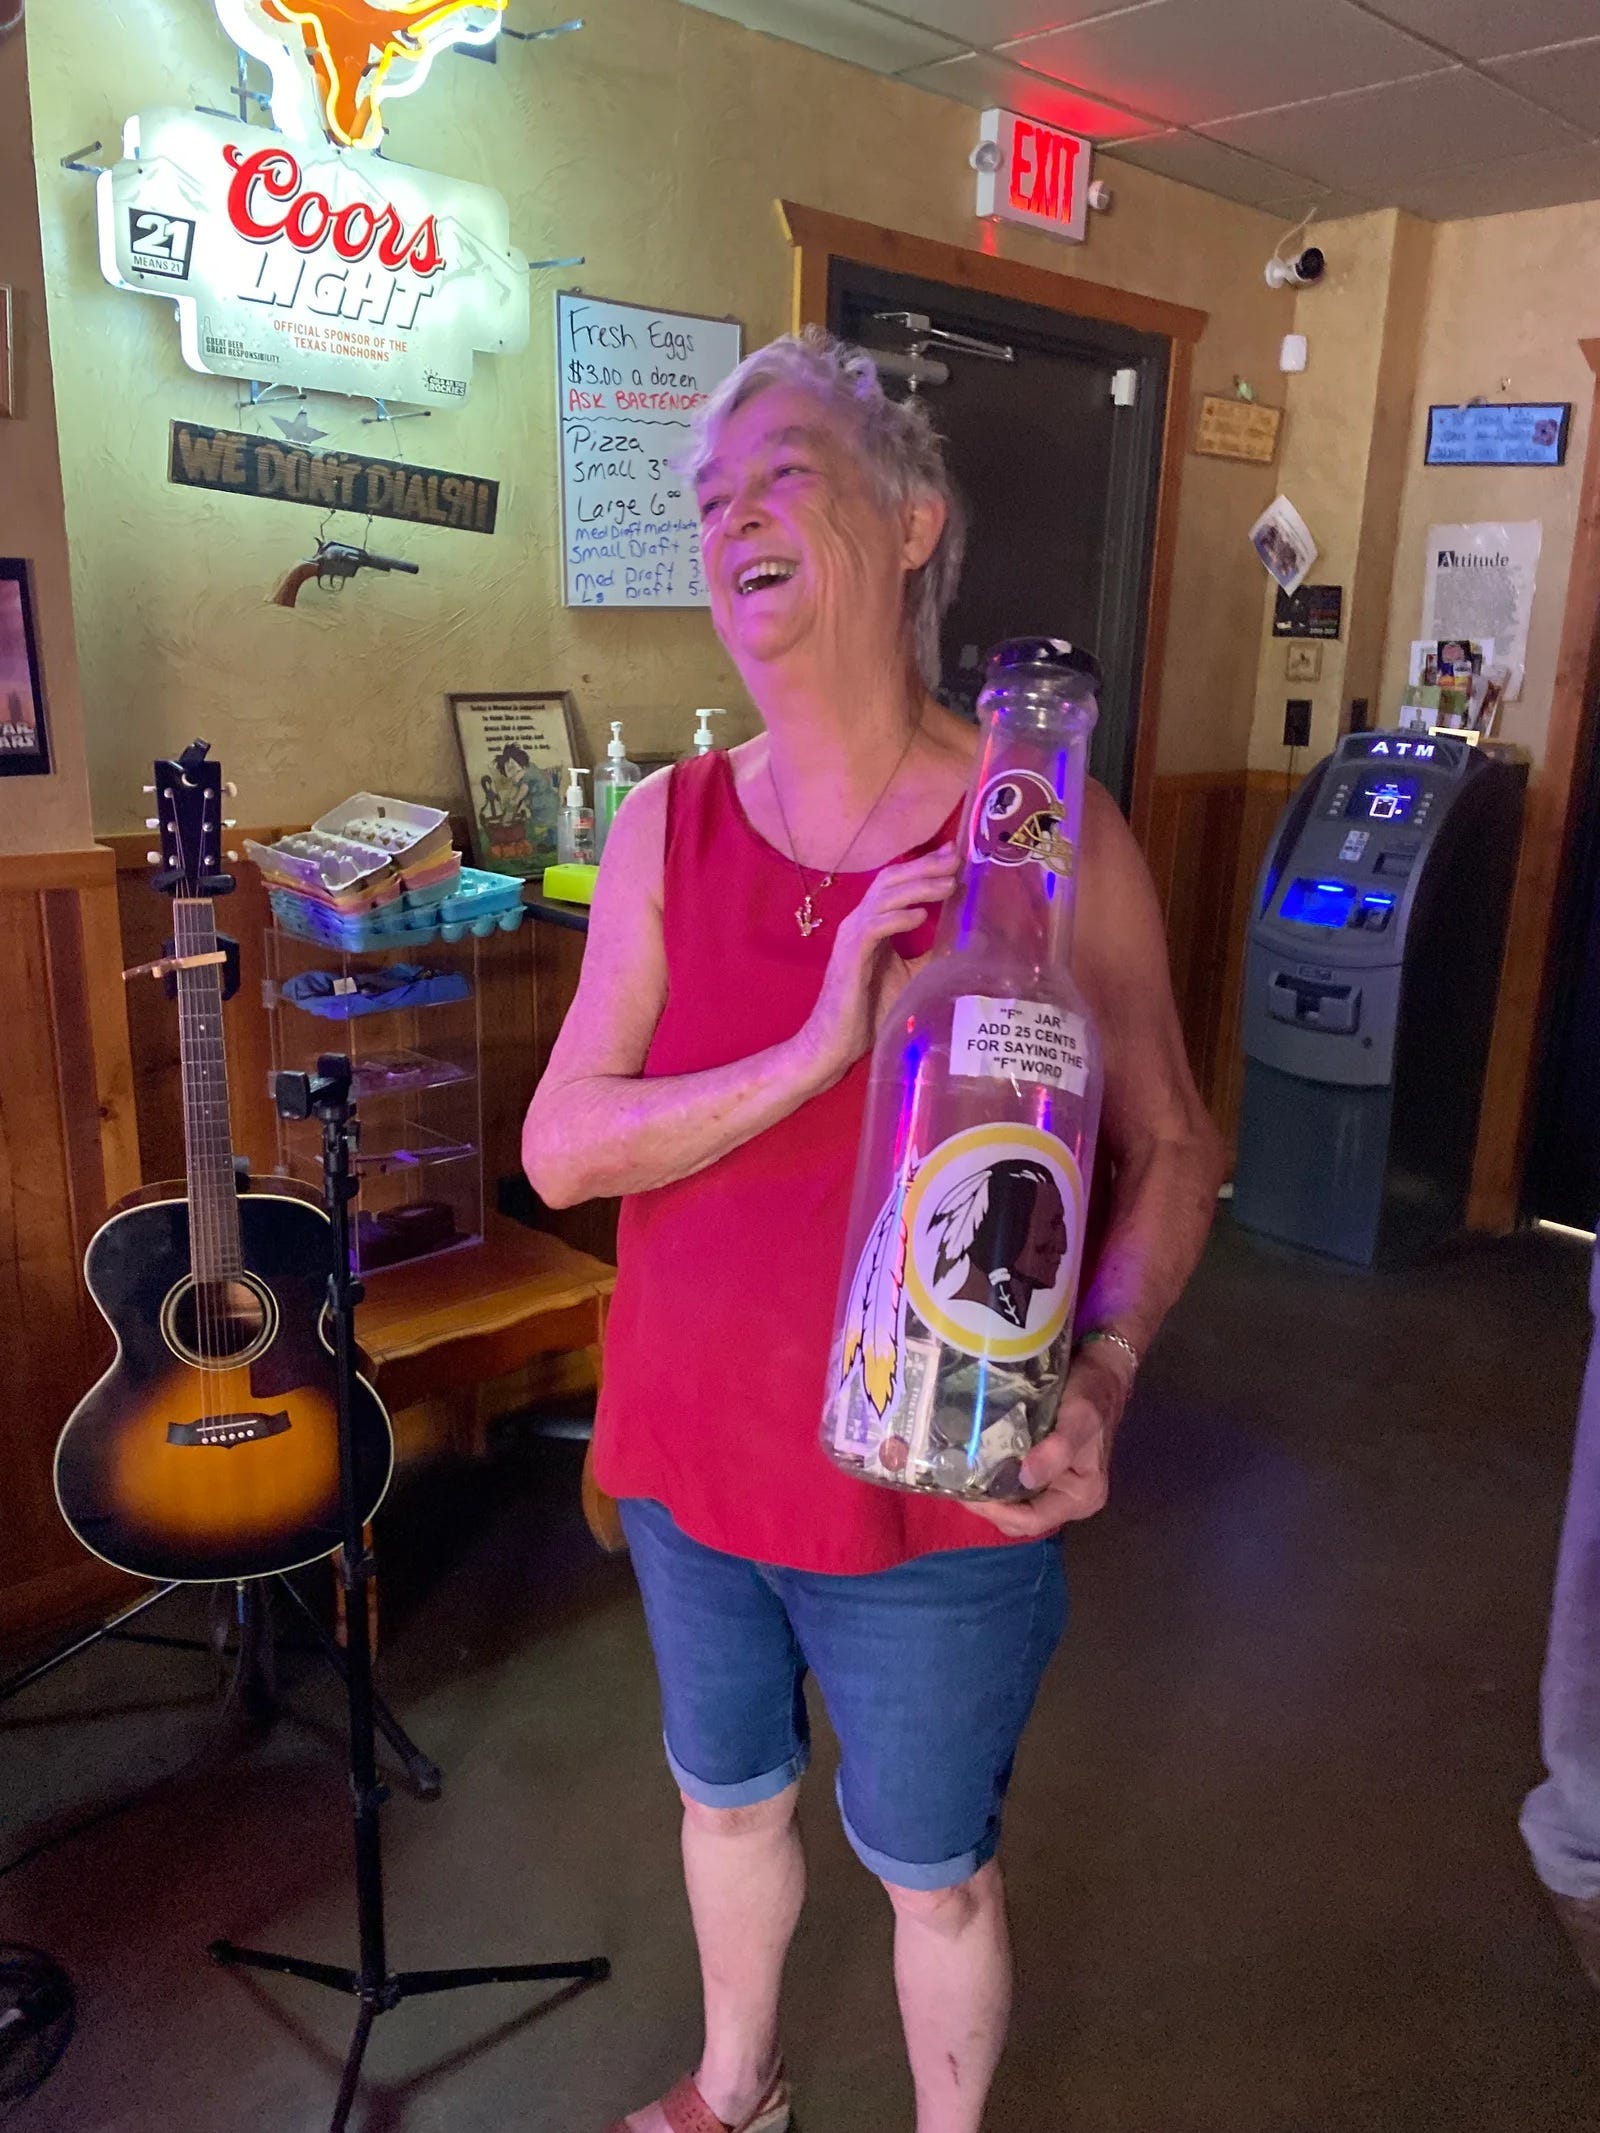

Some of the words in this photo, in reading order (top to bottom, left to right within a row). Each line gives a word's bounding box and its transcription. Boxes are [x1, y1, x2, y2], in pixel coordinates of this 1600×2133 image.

[1008, 120, 1080, 225] EXIT
[222, 143, 446, 276] Coors
[132, 213, 190, 261] 21
[133, 255, 169, 271] MEANS
[171, 262, 180, 273] 21
[236, 250, 435, 330] LIGHT
[206, 336, 226, 347] GREAT
[228, 339, 243, 349] BEER
[273, 319, 321, 338] OFFICIAL
[324, 328, 370, 346] SPONSOR
[374, 336, 386, 348] OF
[389, 339, 408, 353] THE
[569, 306, 637, 352] Fresh
[648, 320, 695, 361] Eggs
[206, 345, 227, 355] GREAT
[228, 347, 280, 364] RESPONSIBILITY
[294, 336, 328, 352] TEXAS
[330, 344, 390, 362] LONGHORNS
[568, 359, 622, 385] $3.00
[631, 371, 643, 387] a
[651, 369, 698, 391] dozen
[568, 389, 607, 412] ASK
[616, 389, 708, 411] BARTENDE
[567, 424, 644, 453] Pizza
[178, 428, 247, 484] WE
[365, 465, 447, 522] DIAL
[578, 496, 641, 525] Large
[629, 537, 679, 558] Draft
[1437, 550, 1510, 569] Attitude
[625, 562, 675, 585] Draft
[626, 581, 673, 598] Draft
[0, 735, 34, 748] ARS
[1371, 741, 1436, 758] ATM
[1000, 1008, 1023, 1020] "F"
[1034, 1013, 1062, 1029] JAR
[977, 1023, 1011, 1036] ADD
[1015, 1025, 1031, 1039] 25
[1035, 1029, 1077, 1050] CENTS
[967, 1039, 1000, 1051] FOR
[1003, 1041, 1057, 1060] SAYING
[1060, 1050, 1084, 1069] THE
[993, 1056, 1017, 1069] "F"
[1020, 1060, 1063, 1079] WORD
